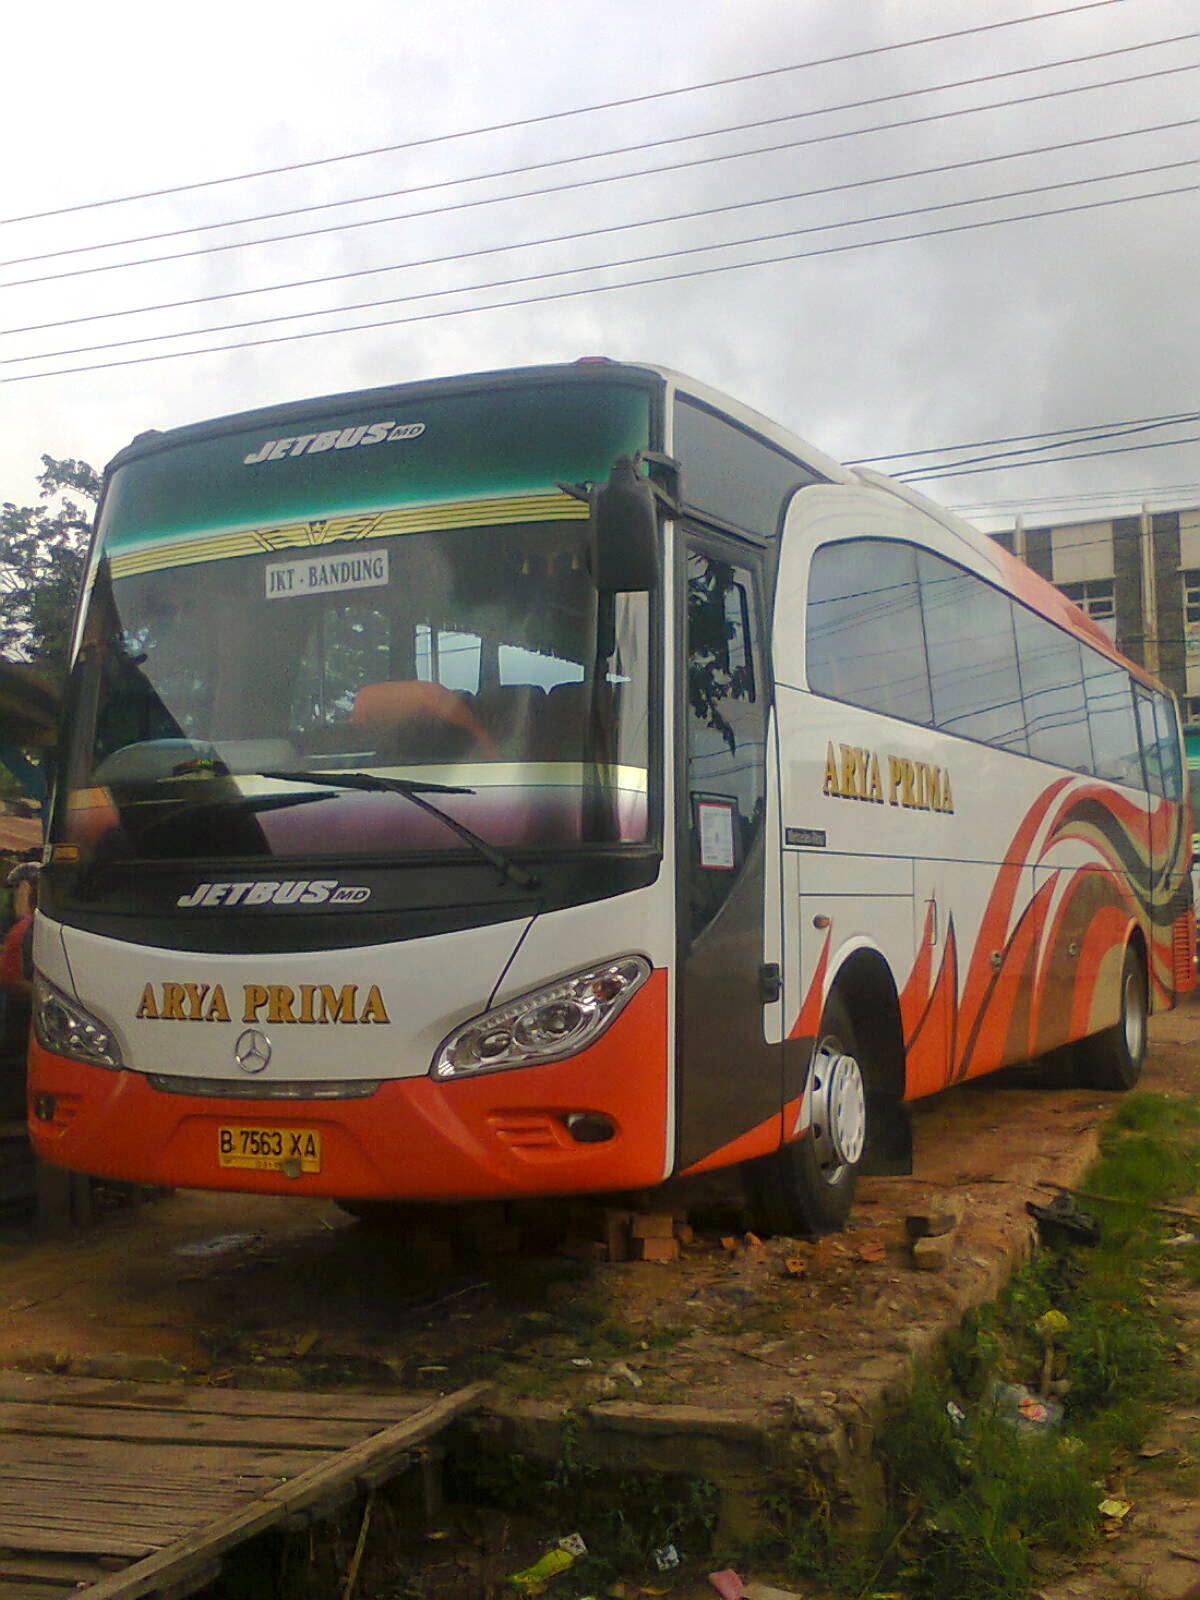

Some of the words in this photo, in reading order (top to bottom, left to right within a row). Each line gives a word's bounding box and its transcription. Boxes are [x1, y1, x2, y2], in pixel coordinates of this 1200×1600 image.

[244, 421, 396, 464] JETBUS
[270, 568, 296, 593] JKT
[308, 557, 384, 588] BANDUNG
[823, 740, 885, 804] ARYA
[887, 754, 955, 815] PRIMA
[177, 880, 339, 908] JETBUS
[331, 887, 371, 904] MD
[135, 982, 232, 1023] ARYA
[241, 984, 391, 1024] PRIMA
[220, 1130, 233, 1153] B
[240, 1130, 283, 1155] 7563
[290, 1132, 317, 1157] XA
